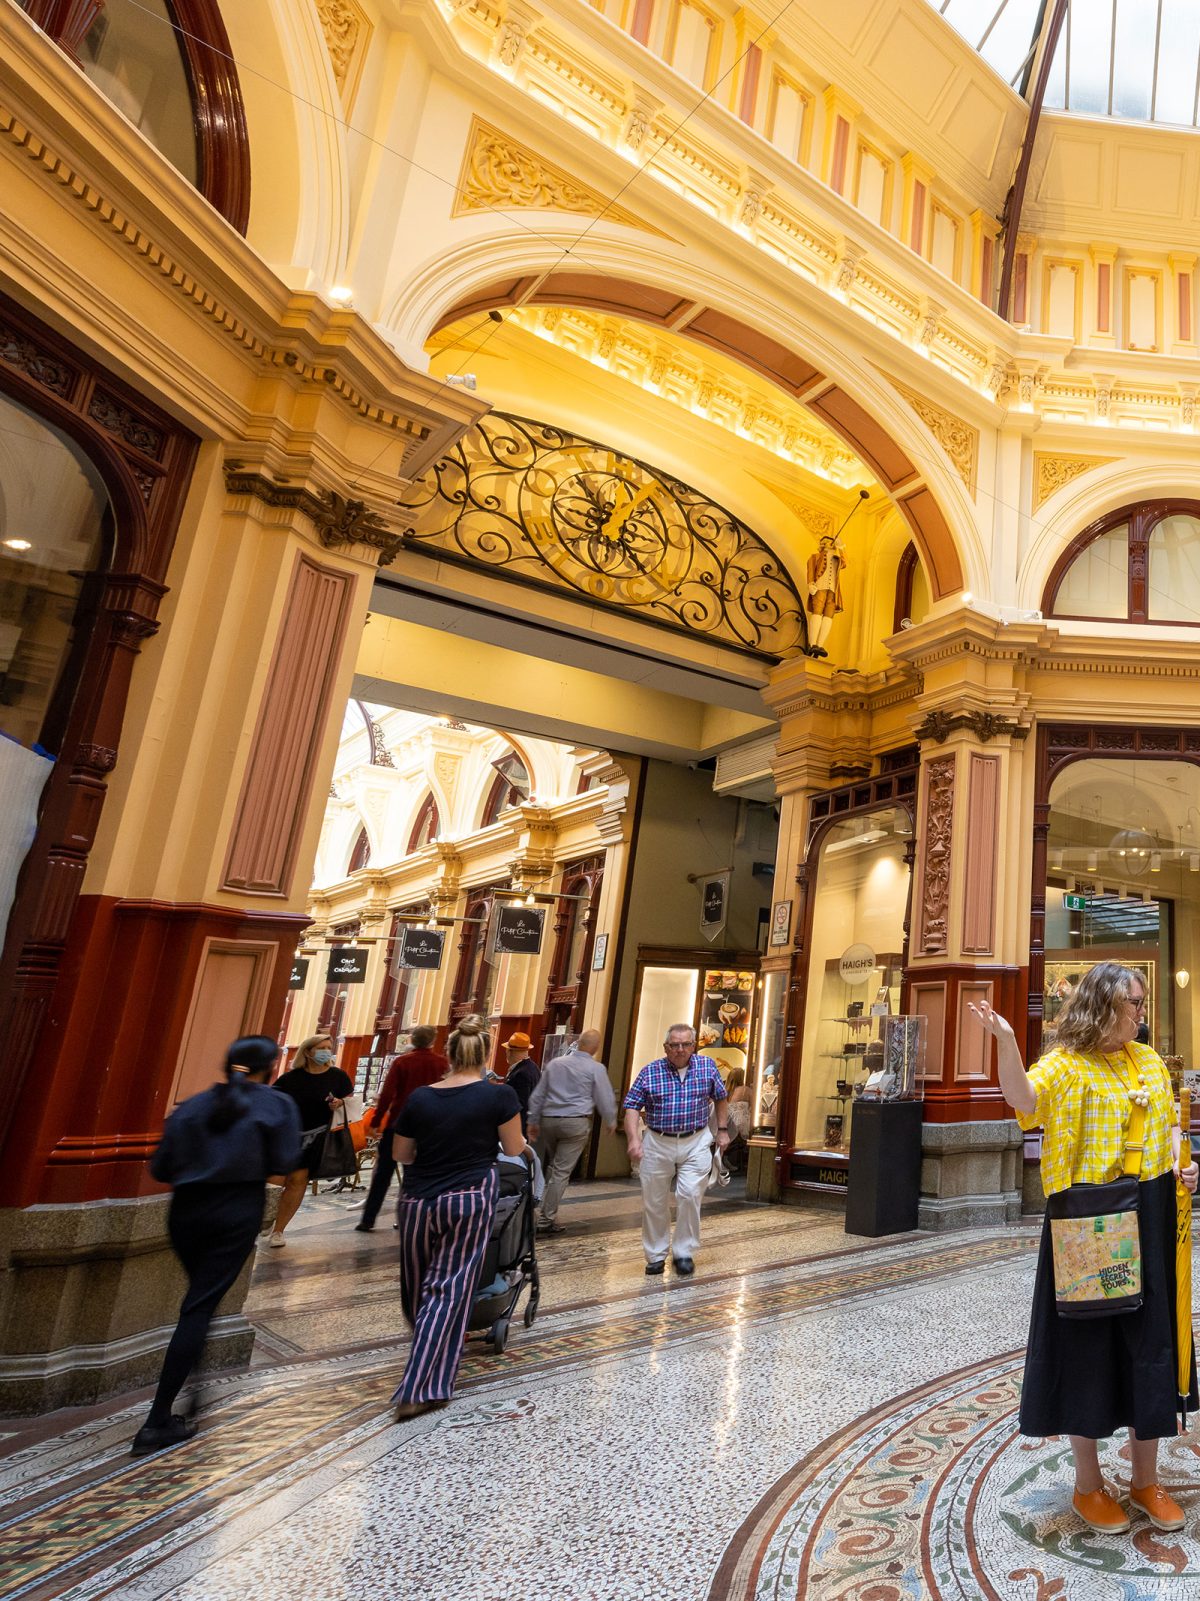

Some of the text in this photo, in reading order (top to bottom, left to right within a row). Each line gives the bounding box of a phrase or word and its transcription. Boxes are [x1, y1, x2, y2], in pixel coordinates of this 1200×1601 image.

[842, 958, 873, 970] HAIGH'S
[1098, 1261, 1129, 1275] HIDDEN
[1100, 1269, 1132, 1283] SECRETS
[1102, 1279, 1127, 1291] TOURS
